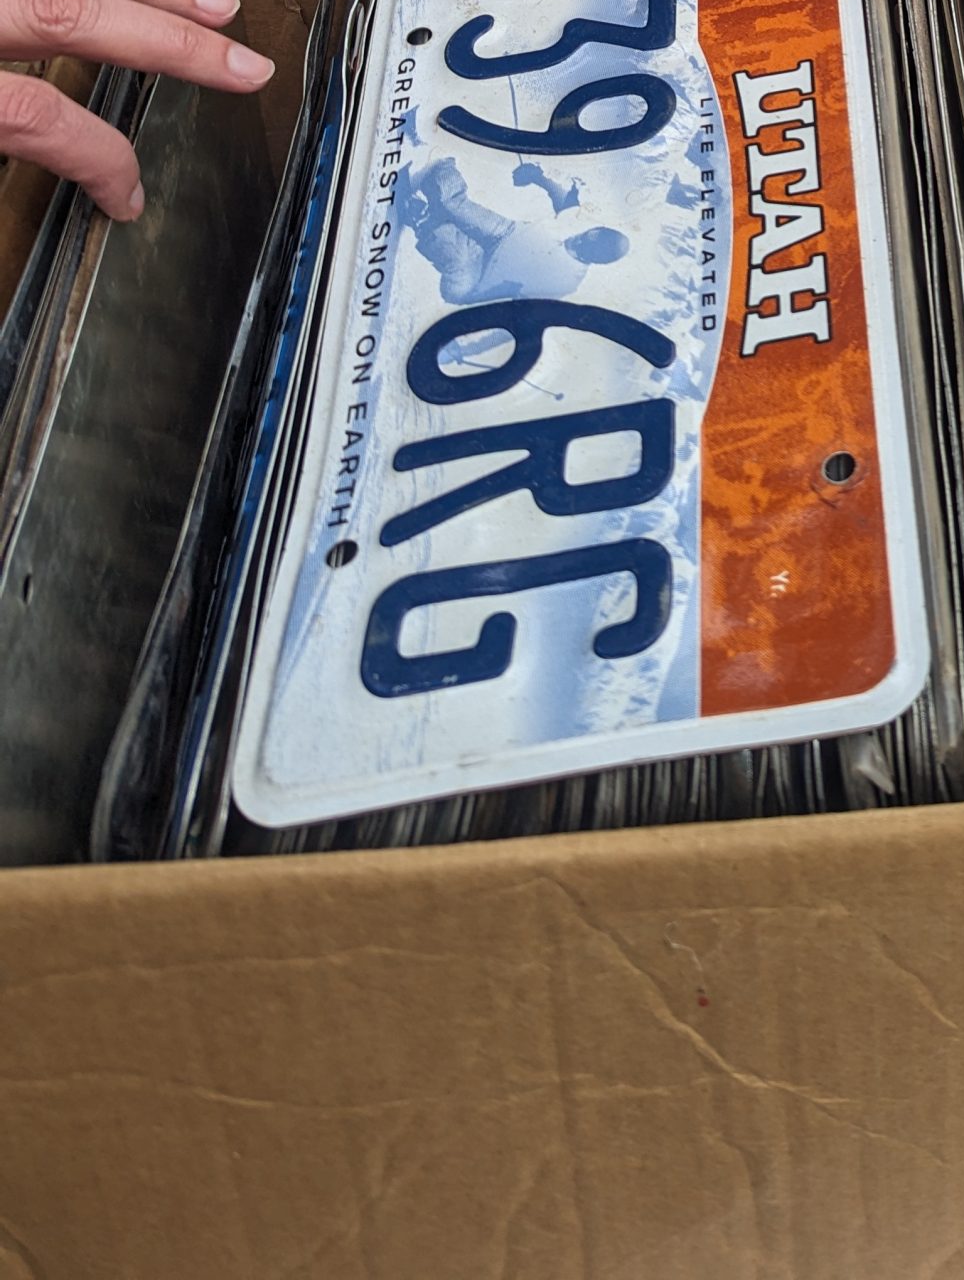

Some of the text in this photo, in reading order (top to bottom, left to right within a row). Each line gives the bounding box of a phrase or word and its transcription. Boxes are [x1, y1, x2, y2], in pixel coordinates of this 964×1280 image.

[331, 57, 416, 528] GREATEST SNOW ON EARTH
[698, 95, 717, 332] LIFE ELEVATED
[733, 59, 831, 360] UTAH
[359, 297, 677, 699] 6RG
[768, 568, 789, 599] Yr.
